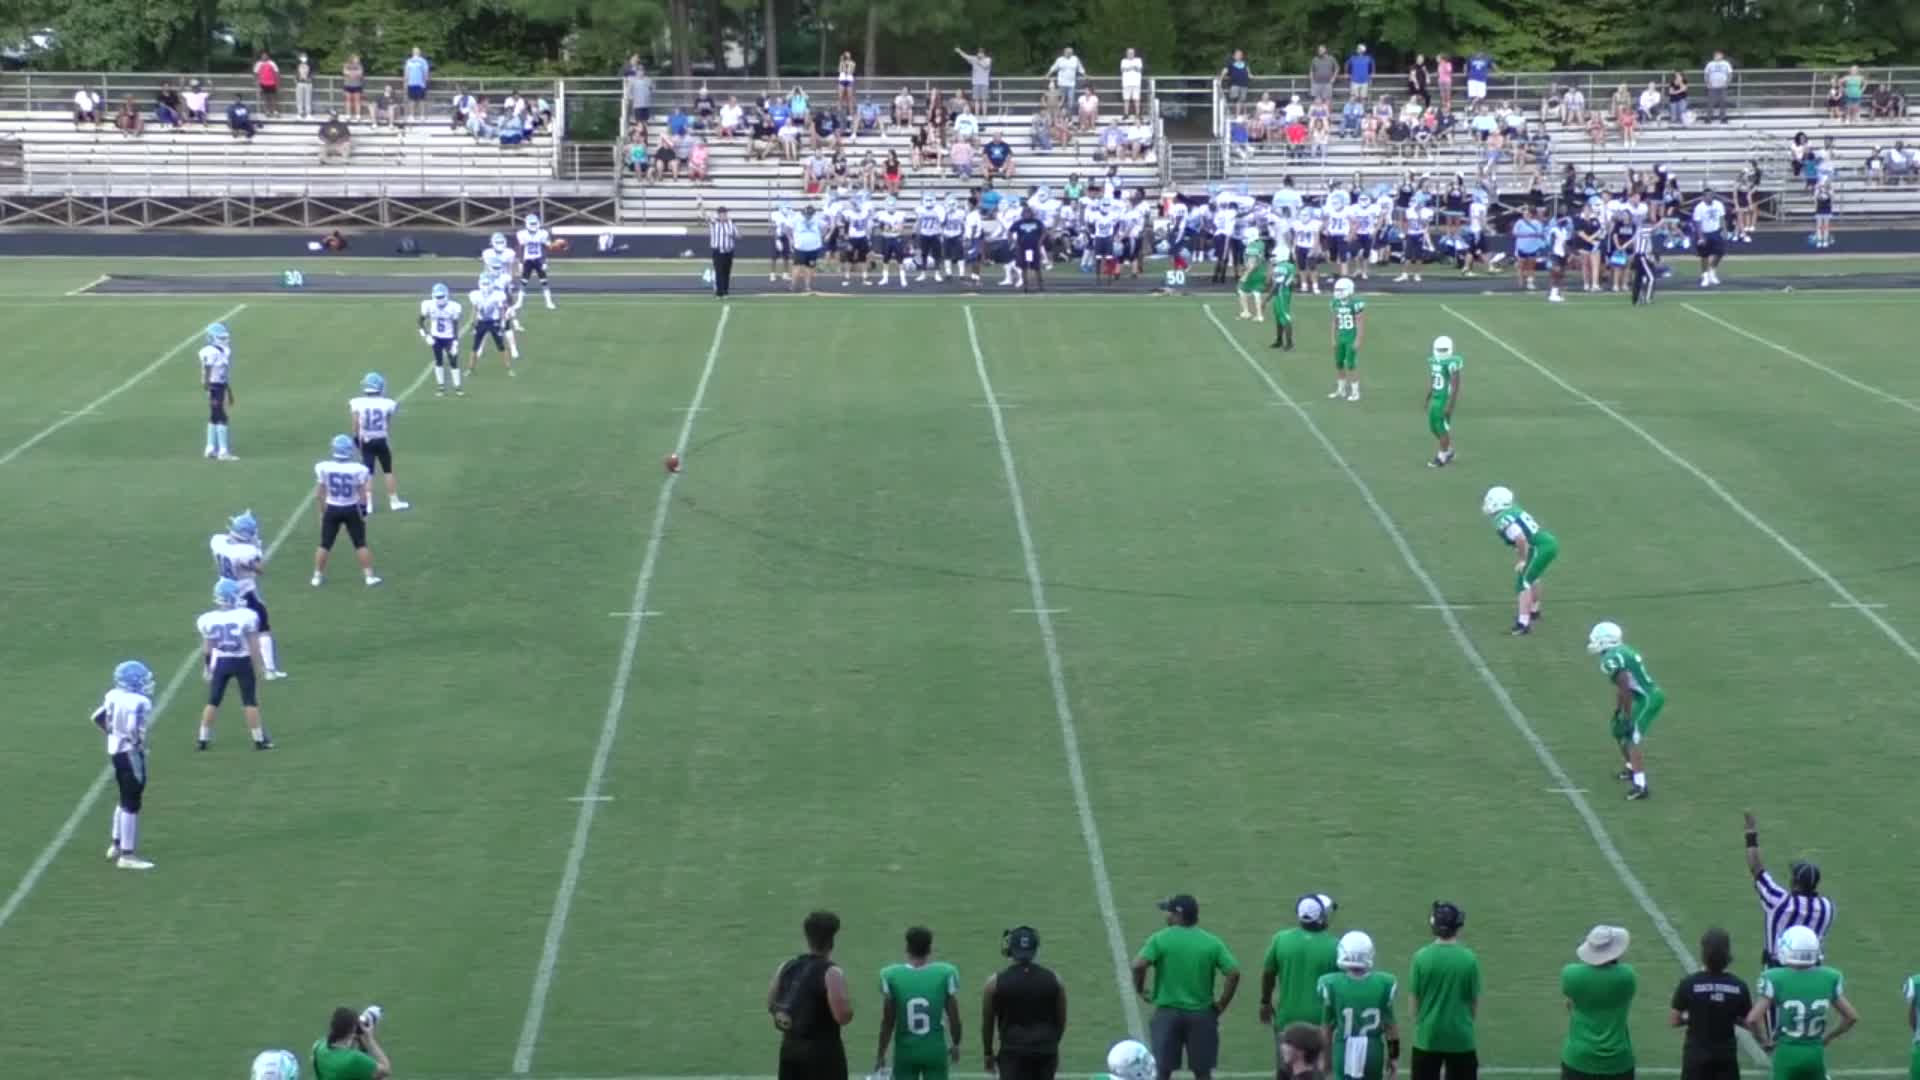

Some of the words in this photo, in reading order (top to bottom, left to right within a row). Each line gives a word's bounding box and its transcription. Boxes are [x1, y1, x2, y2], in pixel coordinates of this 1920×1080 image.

[284, 270, 303, 286] 30
[1166, 271, 1185, 285] 50
[364, 409, 384, 431] 12
[329, 473, 354, 498] 56
[210, 623, 243, 652] 25
[905, 996, 931, 1036] 6
[1340, 1005, 1382, 1037] 12
[1780, 998, 1831, 1041] 32
